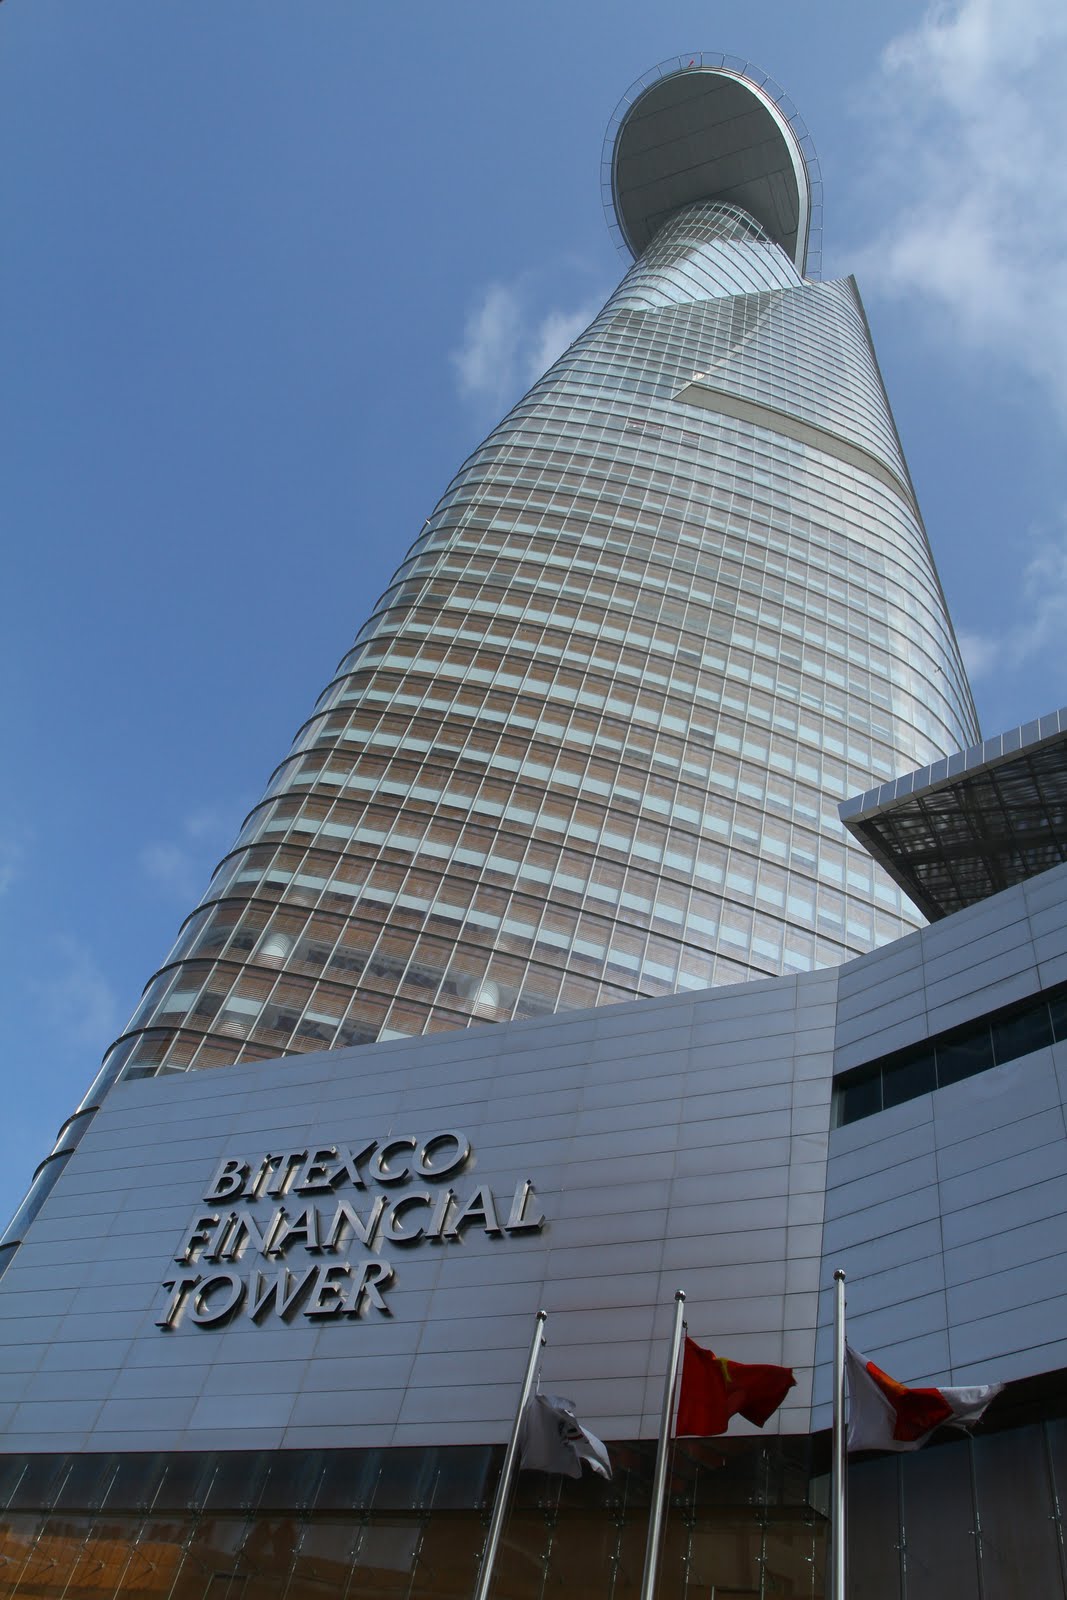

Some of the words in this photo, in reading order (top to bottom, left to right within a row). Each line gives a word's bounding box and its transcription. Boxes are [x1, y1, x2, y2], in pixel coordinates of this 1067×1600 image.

[203, 1129, 472, 1203] BITEXCO
[174, 1179, 547, 1263] FINANCIAL
[154, 1259, 396, 1327] TOWER
